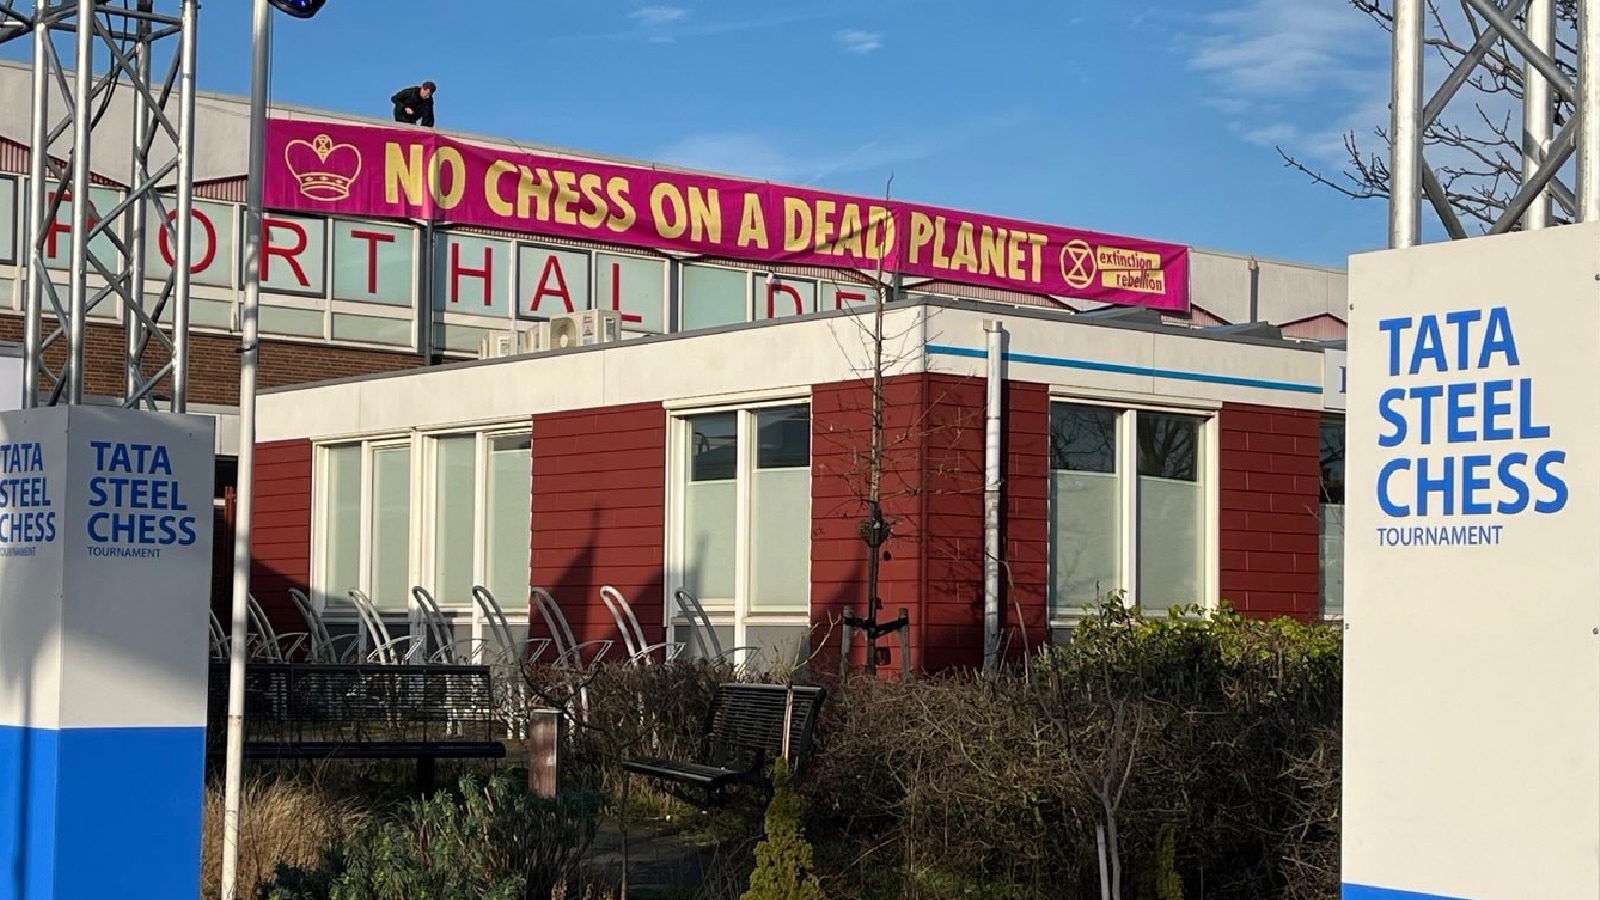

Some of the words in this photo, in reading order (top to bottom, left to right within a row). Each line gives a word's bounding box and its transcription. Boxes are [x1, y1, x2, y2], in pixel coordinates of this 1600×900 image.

[385, 142, 466, 209] NO
[484, 159, 636, 232] CHESS
[650, 182, 722, 244] ON
[738, 192, 768, 249] A
[783, 196, 895, 260] DEAD
[909, 211, 1047, 283] PLANET
[1099, 251, 1153, 269] extinction
[1116, 273, 1163, 291] rebellion
[1379, 305, 1520, 376] TATA
[1378, 378, 1551, 447] STEEL
[0, 442, 43, 474] TATA
[90, 440, 173, 475] TATA
[0, 476, 51, 508] STEEL
[88, 476, 188, 511] STEEL
[1376, 450, 1569, 518] CHESS
[0, 511, 56, 543] CHESS
[86, 512, 197, 546] CHESS
[1376, 525, 1503, 547] TOURNAMENT
[87, 546, 161, 558] TOURNAMENT
